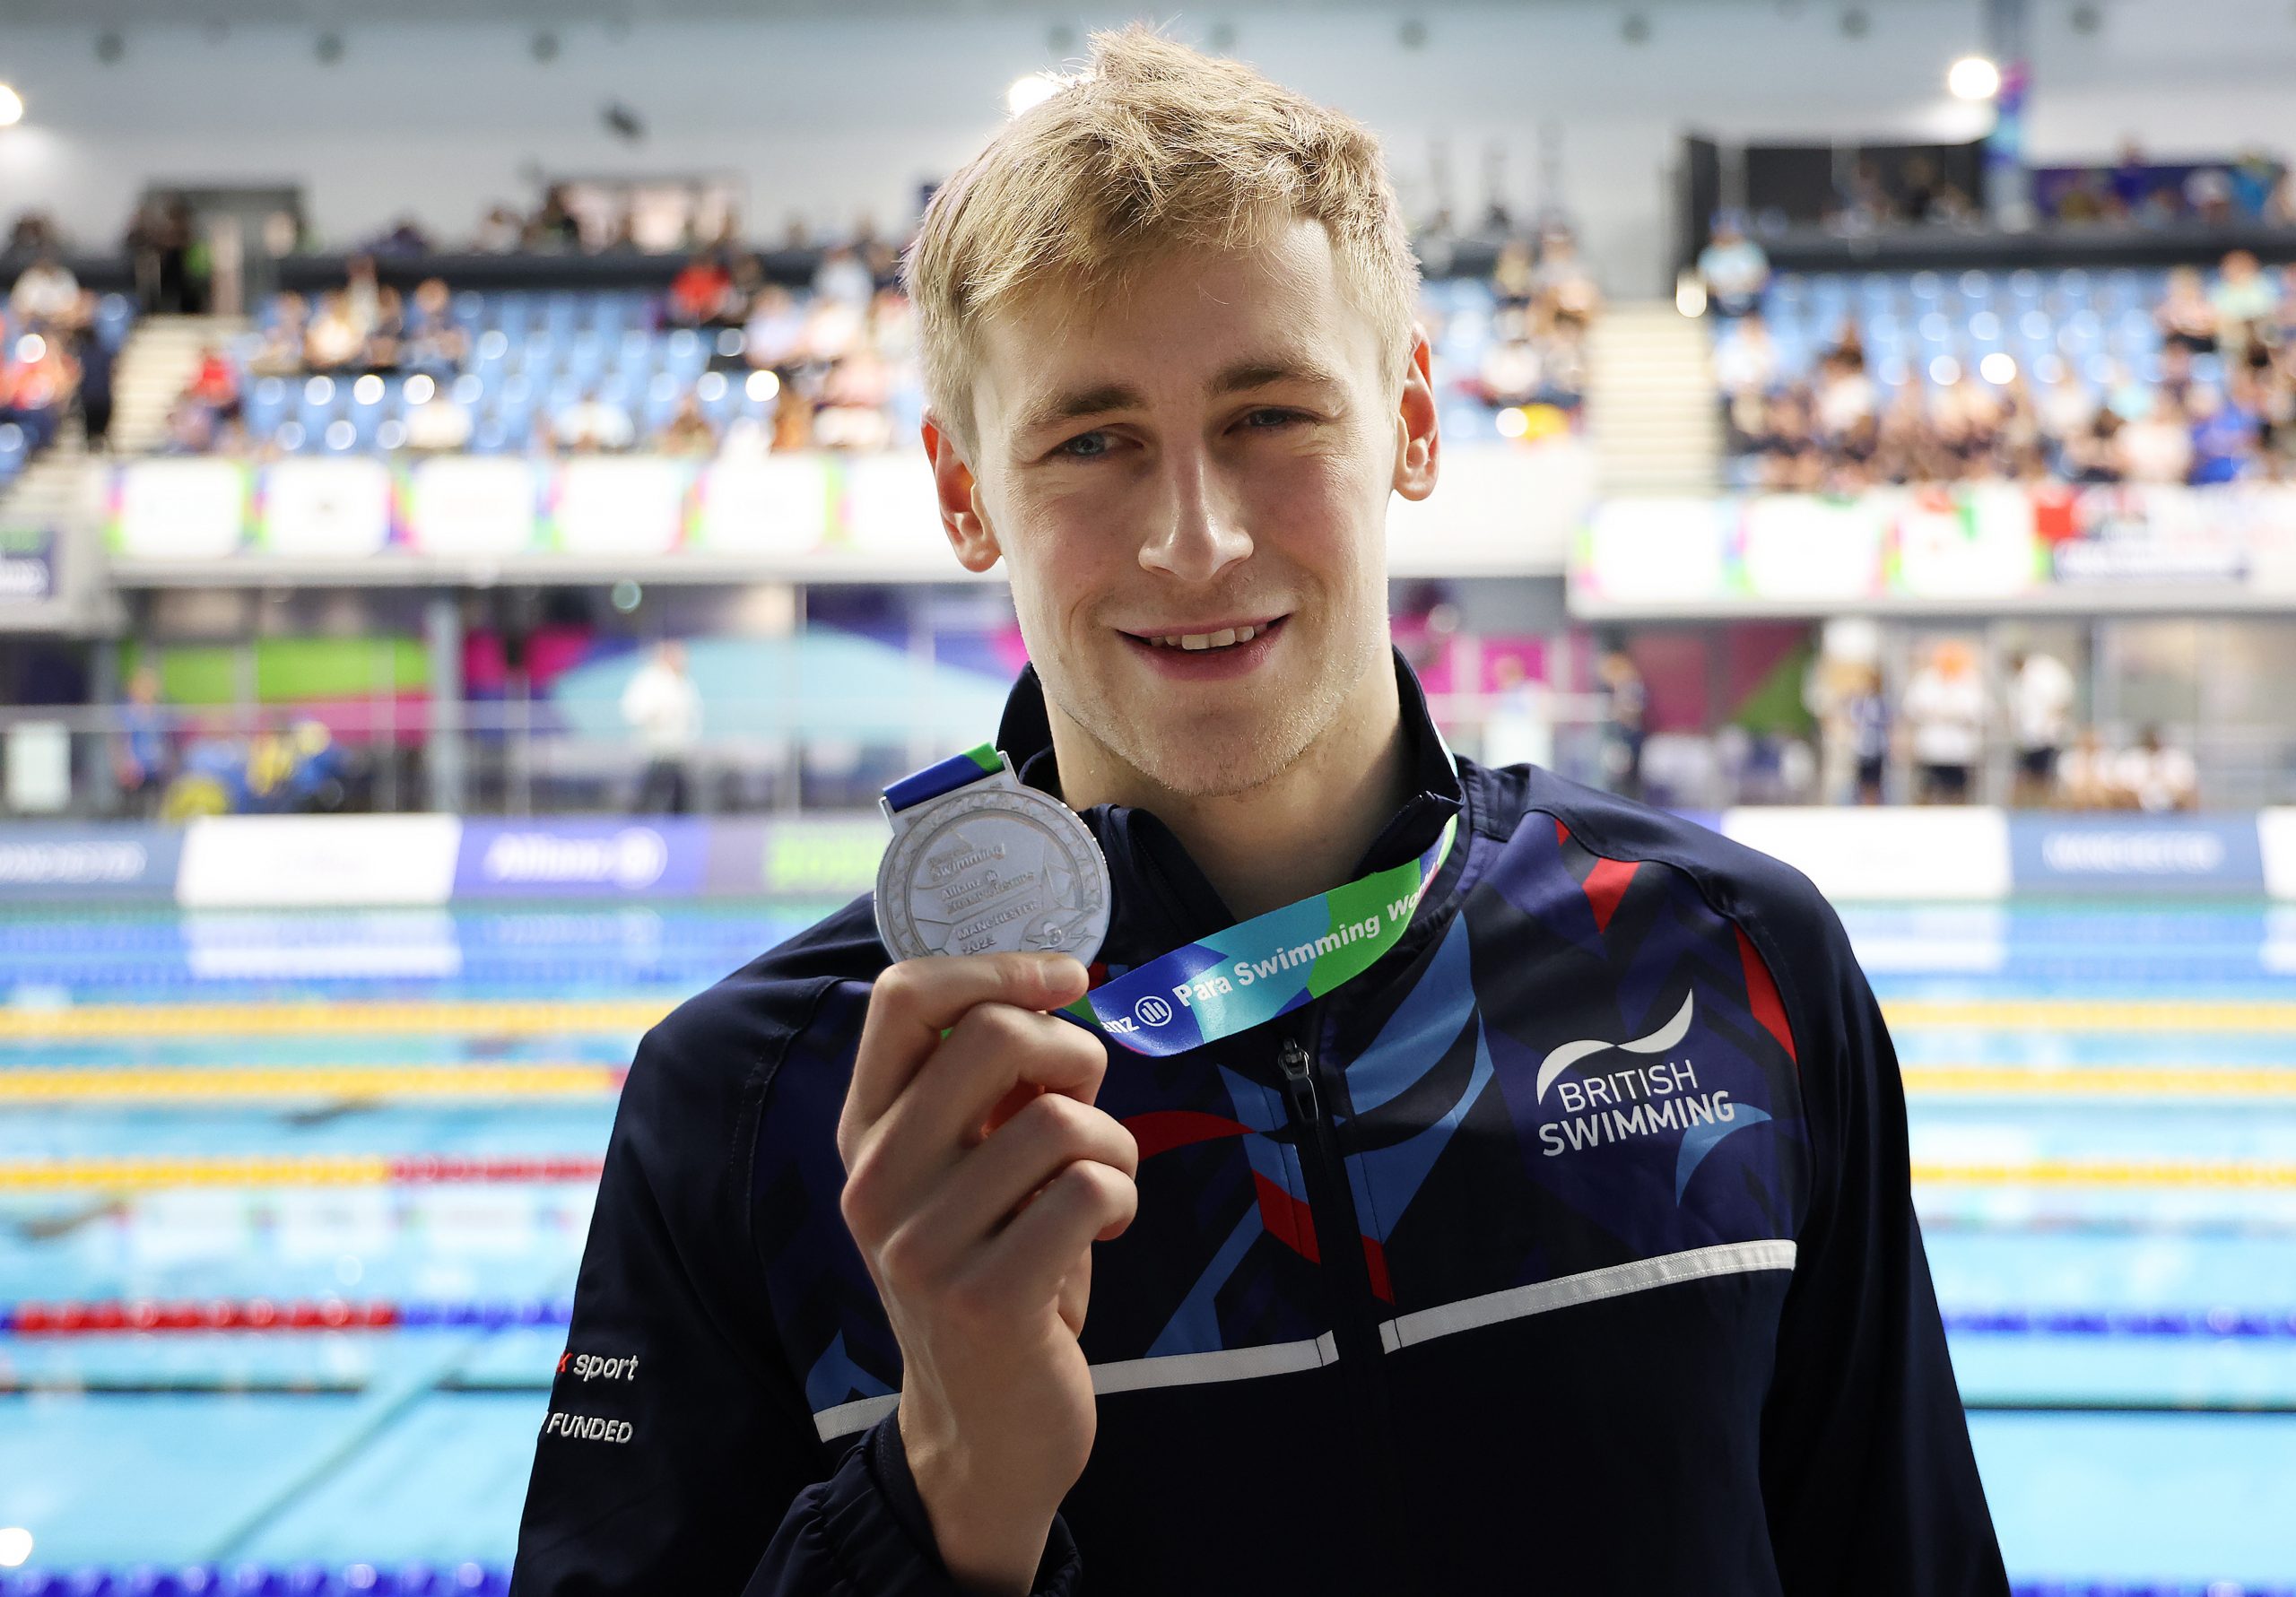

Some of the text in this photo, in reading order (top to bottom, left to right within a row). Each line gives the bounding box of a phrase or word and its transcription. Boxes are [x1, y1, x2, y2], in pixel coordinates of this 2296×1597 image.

[1100, 1016, 1140, 1033] anz
[1171, 973, 1233, 1007] Para
[1234, 914, 1380, 985] Swimming
[1557, 1059, 1699, 1113] BRITISH
[1538, 1090, 1735, 1157] SWIMMING
[573, 1354, 639, 1382] sport
[546, 1412, 633, 1444] FUNDED
